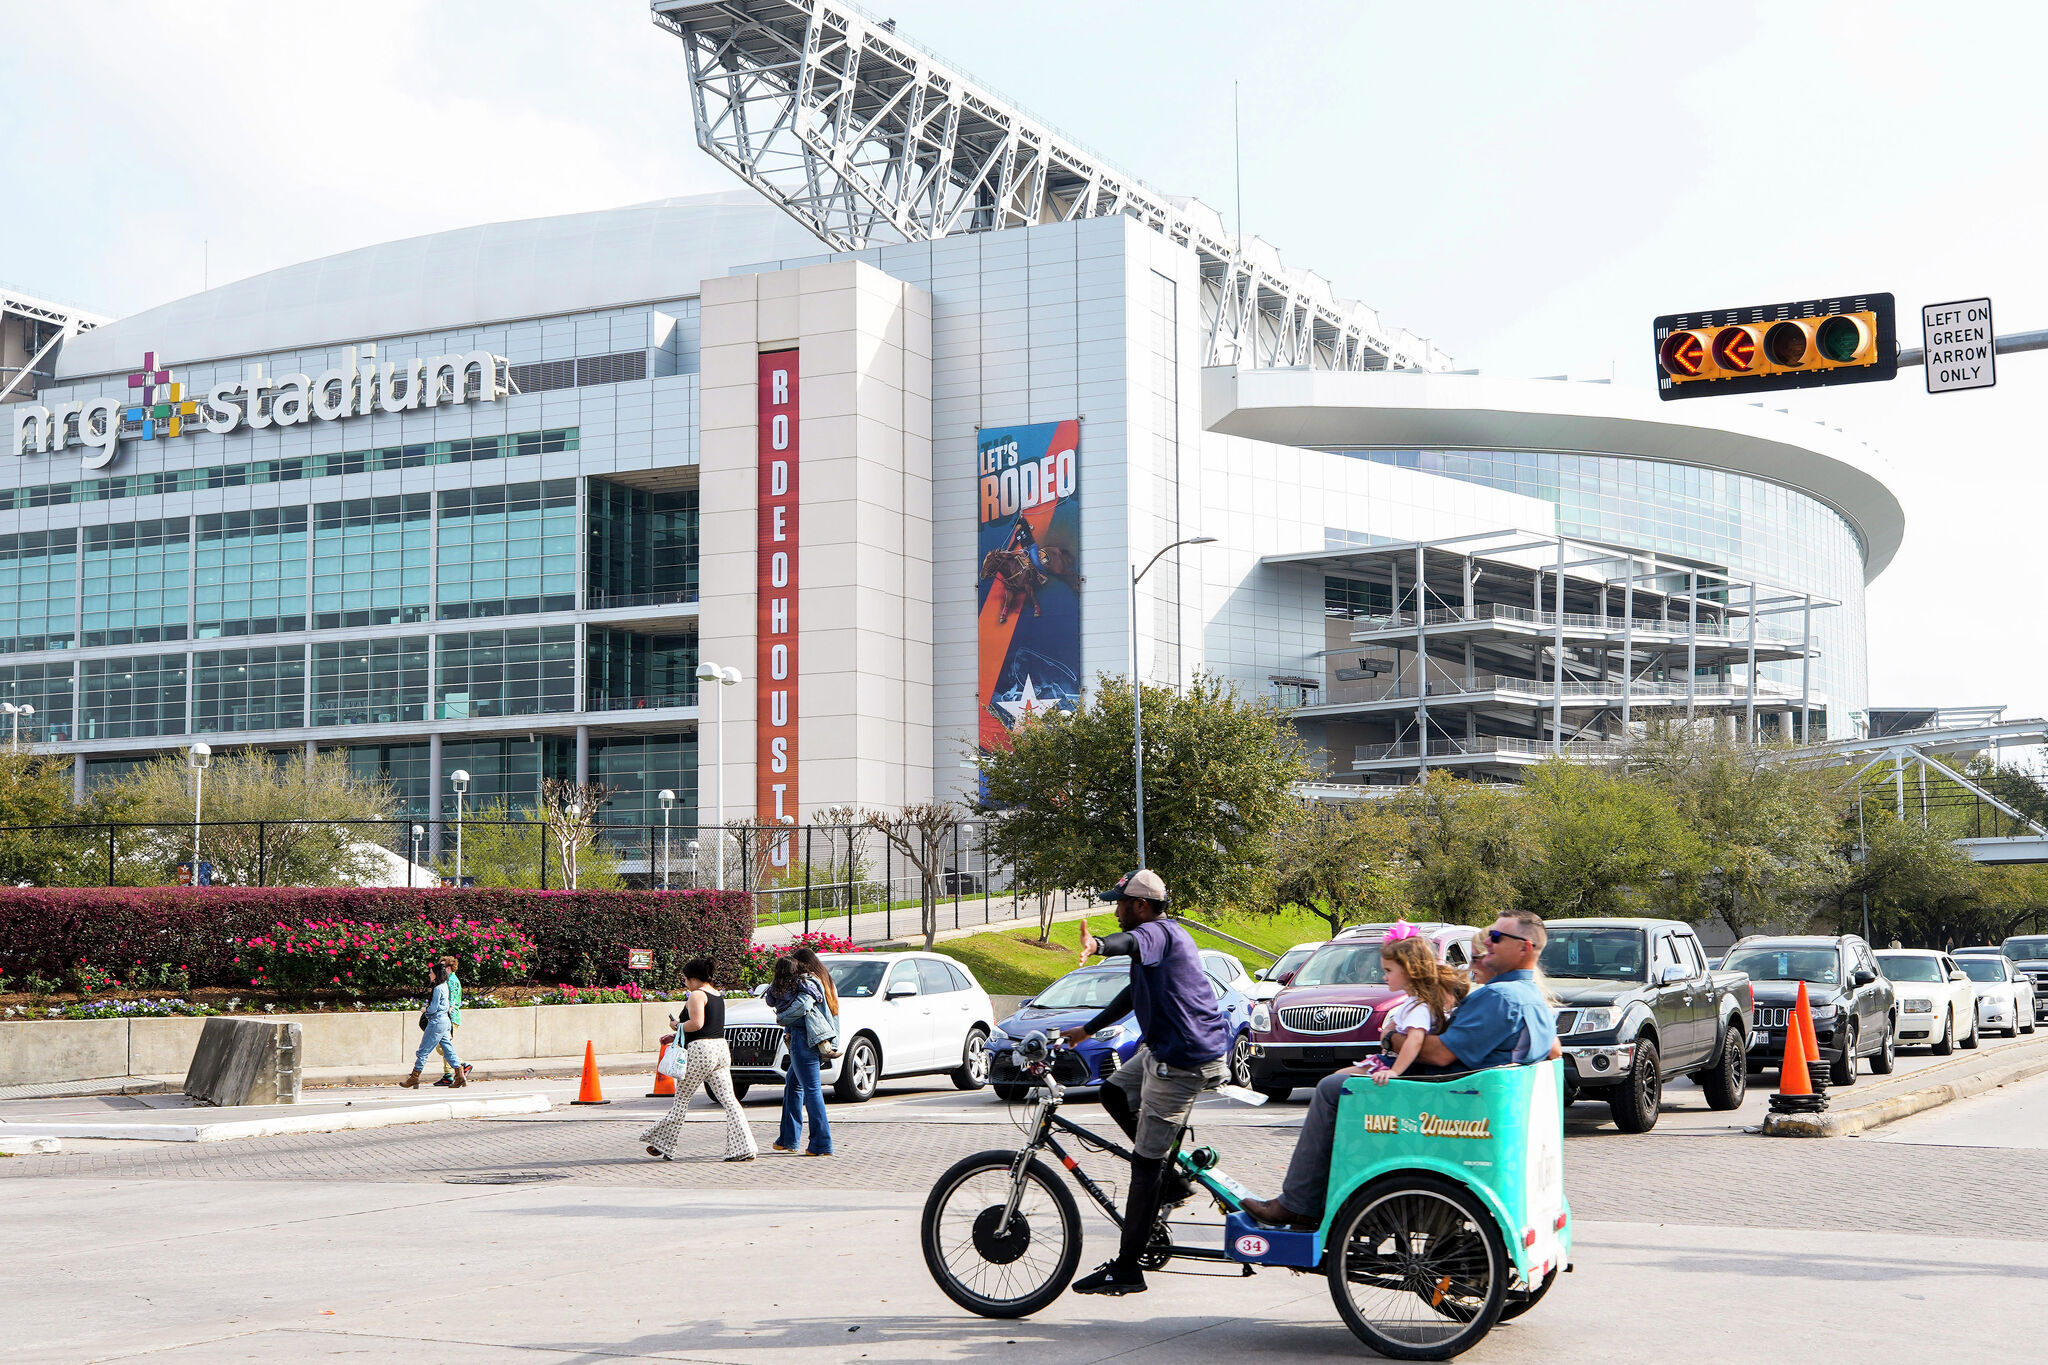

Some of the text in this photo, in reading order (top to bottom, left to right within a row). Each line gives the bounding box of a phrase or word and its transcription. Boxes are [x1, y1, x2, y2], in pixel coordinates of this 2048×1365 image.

[1926, 307, 1988, 328] LEFT ON
[1933, 327, 1984, 345] GREEN
[1932, 346, 1987, 365] ARROW
[1940, 366, 1981, 383] ONLY
[13, 343, 496, 470] nrg stadium
[980, 441, 1018, 476] LET'S
[980, 448, 1076, 524] RODEO
[1364, 1114, 1398, 1134] HAVE
[1242, 1239, 1262, 1252] 34
